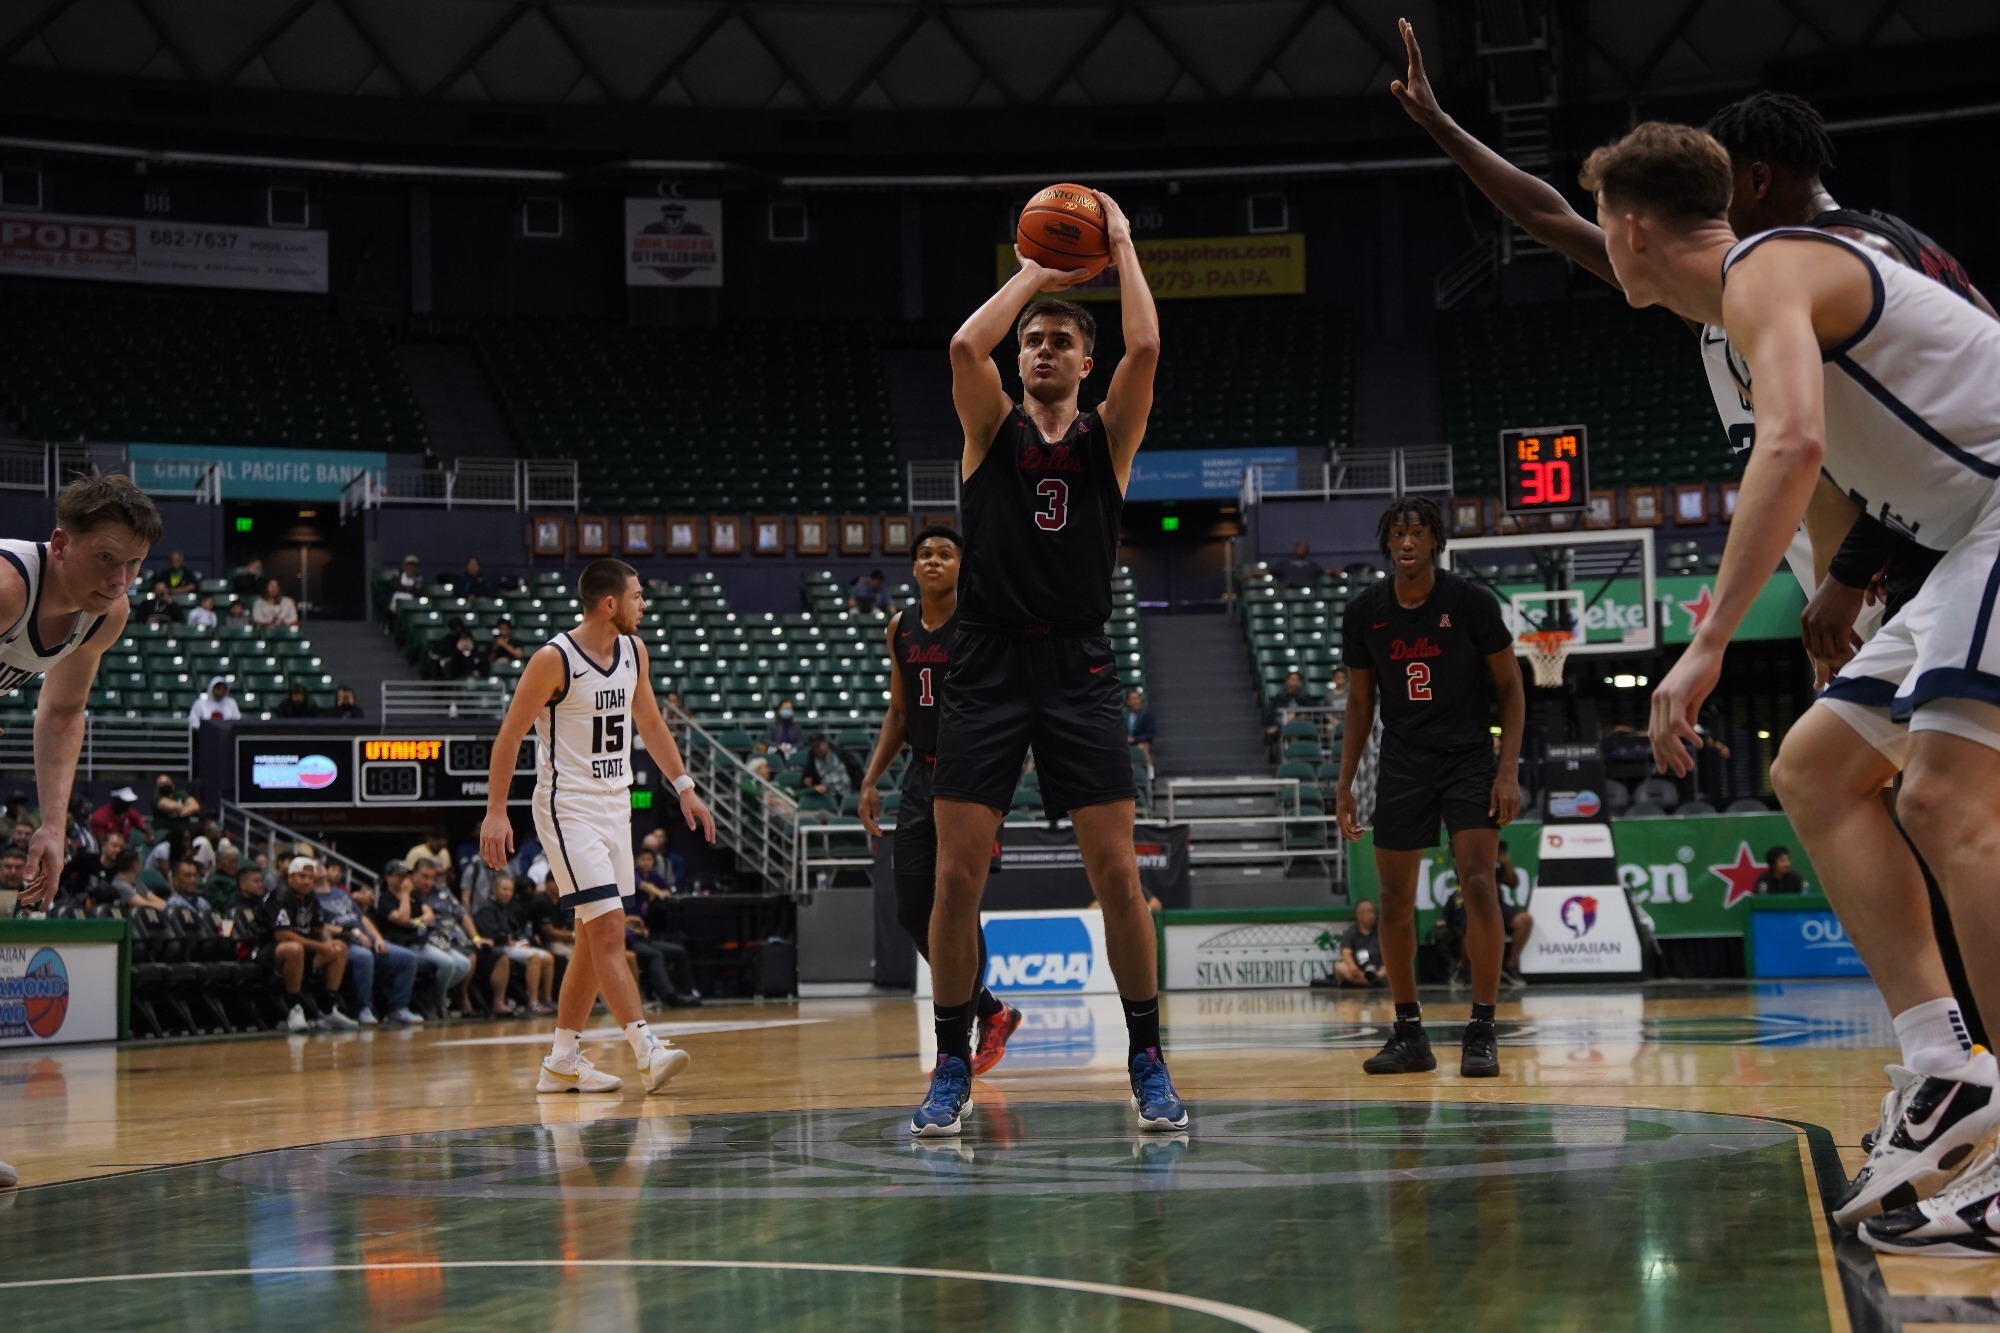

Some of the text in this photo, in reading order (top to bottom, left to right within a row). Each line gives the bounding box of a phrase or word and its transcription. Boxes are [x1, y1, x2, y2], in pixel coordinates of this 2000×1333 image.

[1, 222, 132, 252] PODS
[150, 228, 239, 249] 682-7637
[241, 460, 309, 483] PACIFIC
[1018, 444, 1085, 474] Dallas
[1520, 460, 1571, 504] 30
[1034, 478, 1068, 531] 3
[907, 643, 949, 664] Dallas
[1390, 637, 1442, 660] Dallas
[919, 668, 934, 706] 1
[1406, 662, 1432, 700] 2
[595, 688, 625, 710] UTAH
[592, 714, 625, 753] 15
[365, 741, 442, 760] UTAHST
[592, 758, 624, 778] STATE
[1539, 942, 1622, 956] HAWAIIAN
[986, 953, 1089, 986] NCAA
[1197, 959, 1338, 985] STAN SHERIFF CENT
